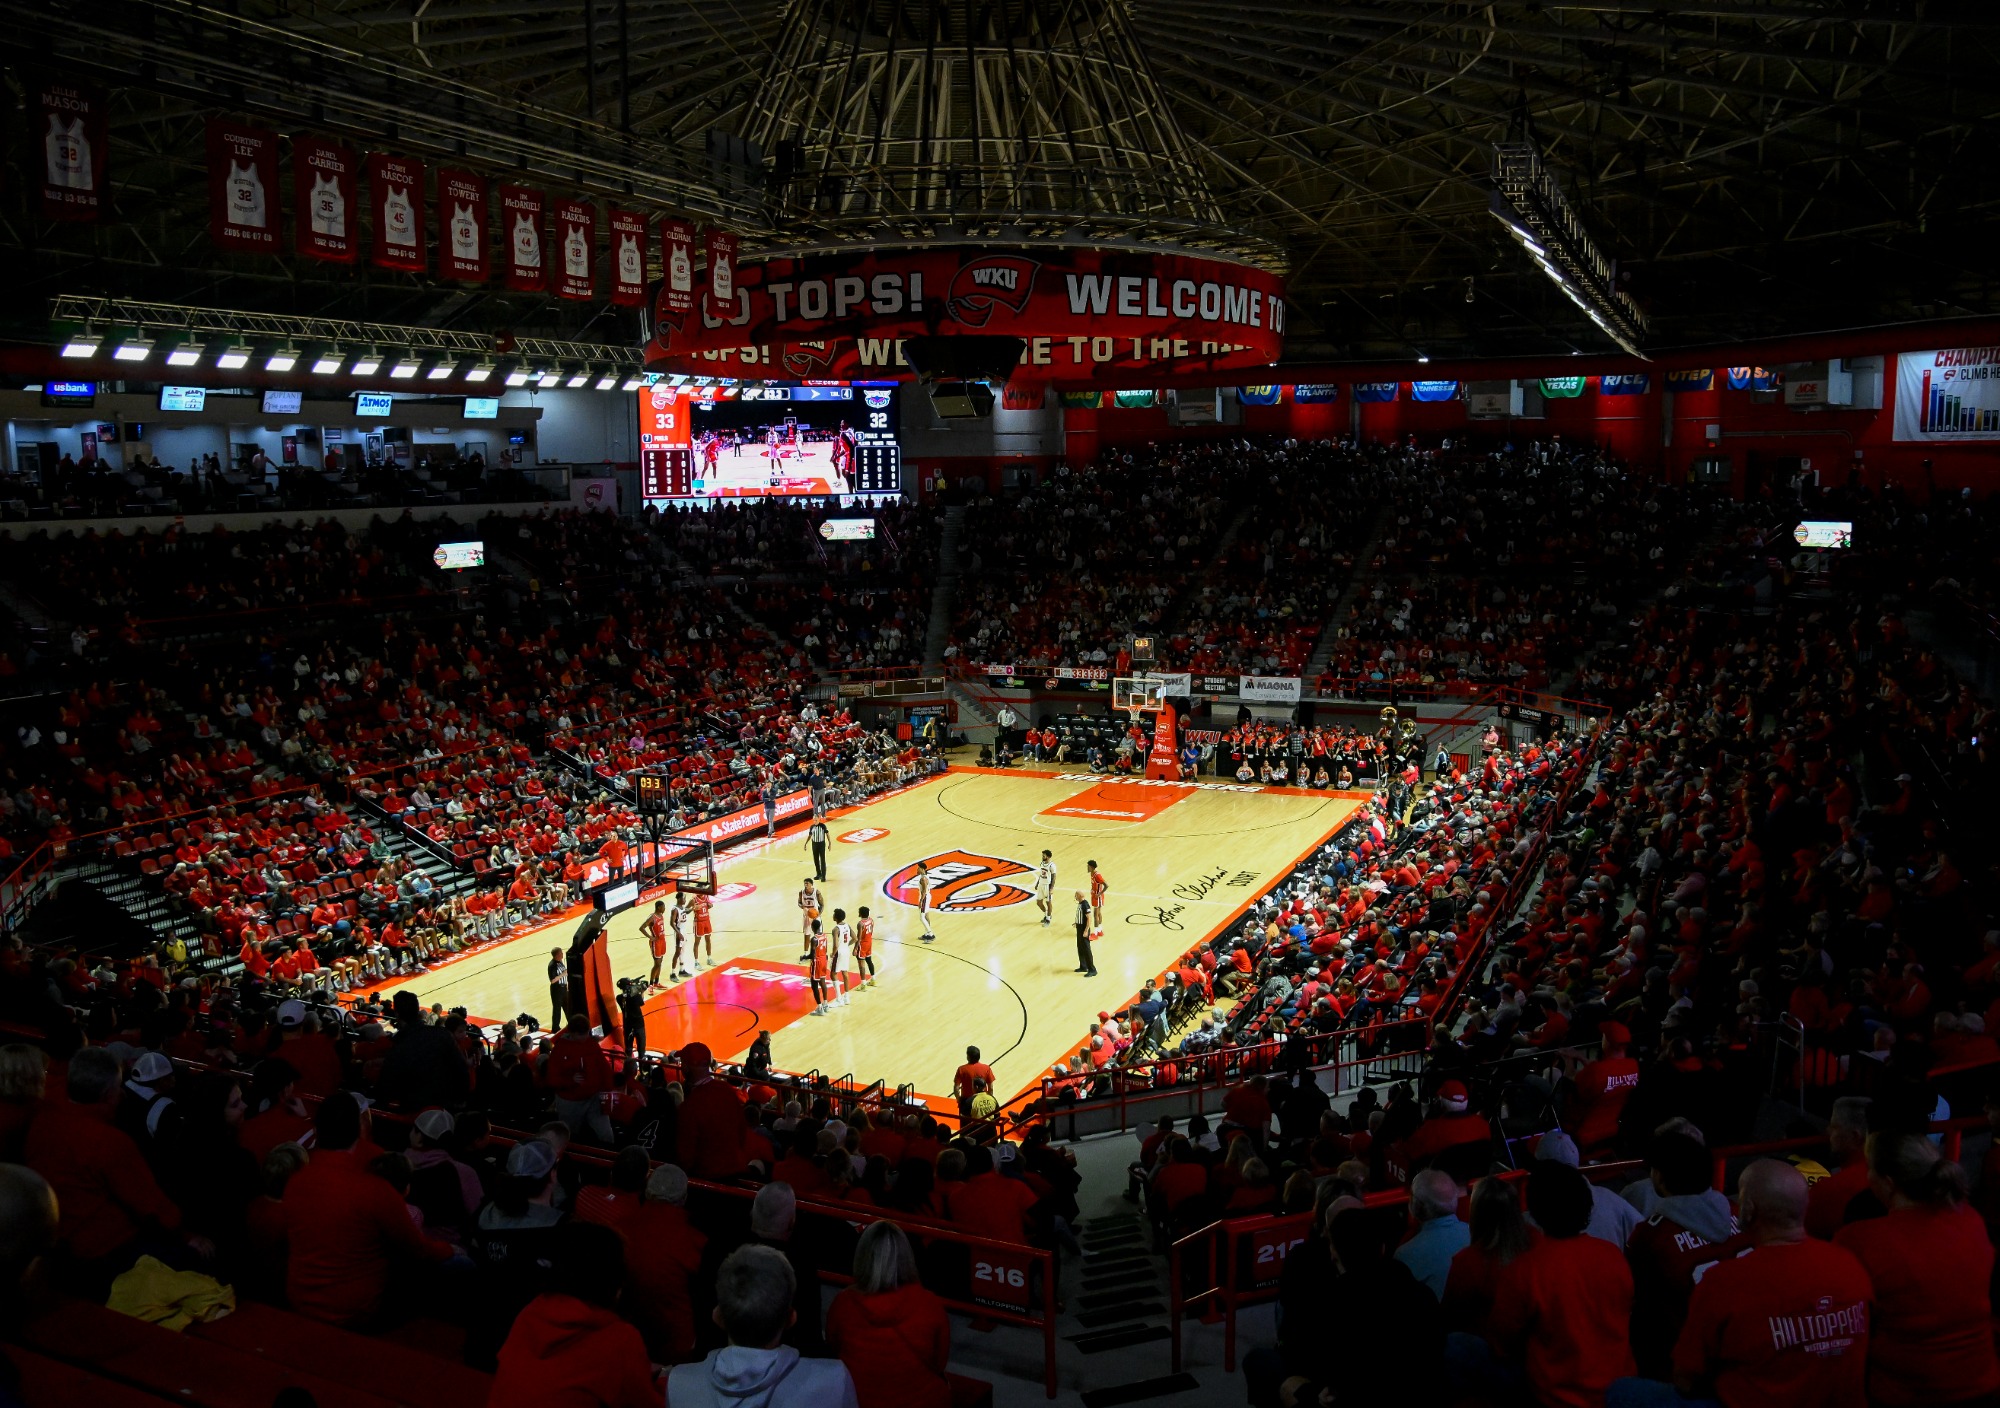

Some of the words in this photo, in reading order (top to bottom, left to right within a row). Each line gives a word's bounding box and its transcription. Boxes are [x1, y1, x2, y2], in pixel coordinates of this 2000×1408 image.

[42, 93, 88, 113] MASON
[224, 133, 263, 148] COURTNEY
[234, 144, 254, 157] LEE
[316, 149, 338, 161] DAREL
[308, 156, 345, 173] CARRIER
[381, 170, 414, 185] RASCOE
[450, 180, 477, 192] CARLISLE
[238, 189, 252, 201] 32
[448, 187, 480, 202] TOWERY
[321, 200, 334, 212] 35
[505, 198, 541, 212] McDANIELS
[394, 212, 405, 224] 45
[561, 211, 590, 225] HASKINS
[460, 228, 470, 239] 42
[613, 221, 644, 233] MARSHALL
[522, 238, 531, 247] 44
[667, 231, 692, 243] OLDHAM
[972, 267, 1018, 290] WKU
[768, 273, 923, 322] TOPS!
[1066, 274, 1262, 328] WELCOME
[1068, 336, 1113, 363] TO
[1604, 374, 1646, 386] RICE
[1667, 369, 1713, 382] UTEP
[1961, 367, 1988, 380] CLIMB
[1245, 384, 1272, 396] FIU
[1296, 388, 1338, 396] ATLANTIC
[1357, 382, 1369, 391] LA
[1371, 382, 1396, 391] TECH
[1546, 381, 1578, 391] TEXAS
[1796, 383, 1818, 394] ACE
[360, 397, 390, 407] ATMOS
[1065, 391, 1096, 400] UAB
[655, 413, 675, 429] 33
[869, 412, 888, 429] 32
[1257, 681, 1295, 691] MAGNA
[1185, 729, 1222, 745] WKU
[208, 938, 216, 951] A
[843, 933, 848, 943] 5
[974, 1261, 1025, 1288] 216
[975, 1296, 1027, 1313] HILLTOPPERS
[1768, 1300, 1866, 1352] HILLTOPPERS
